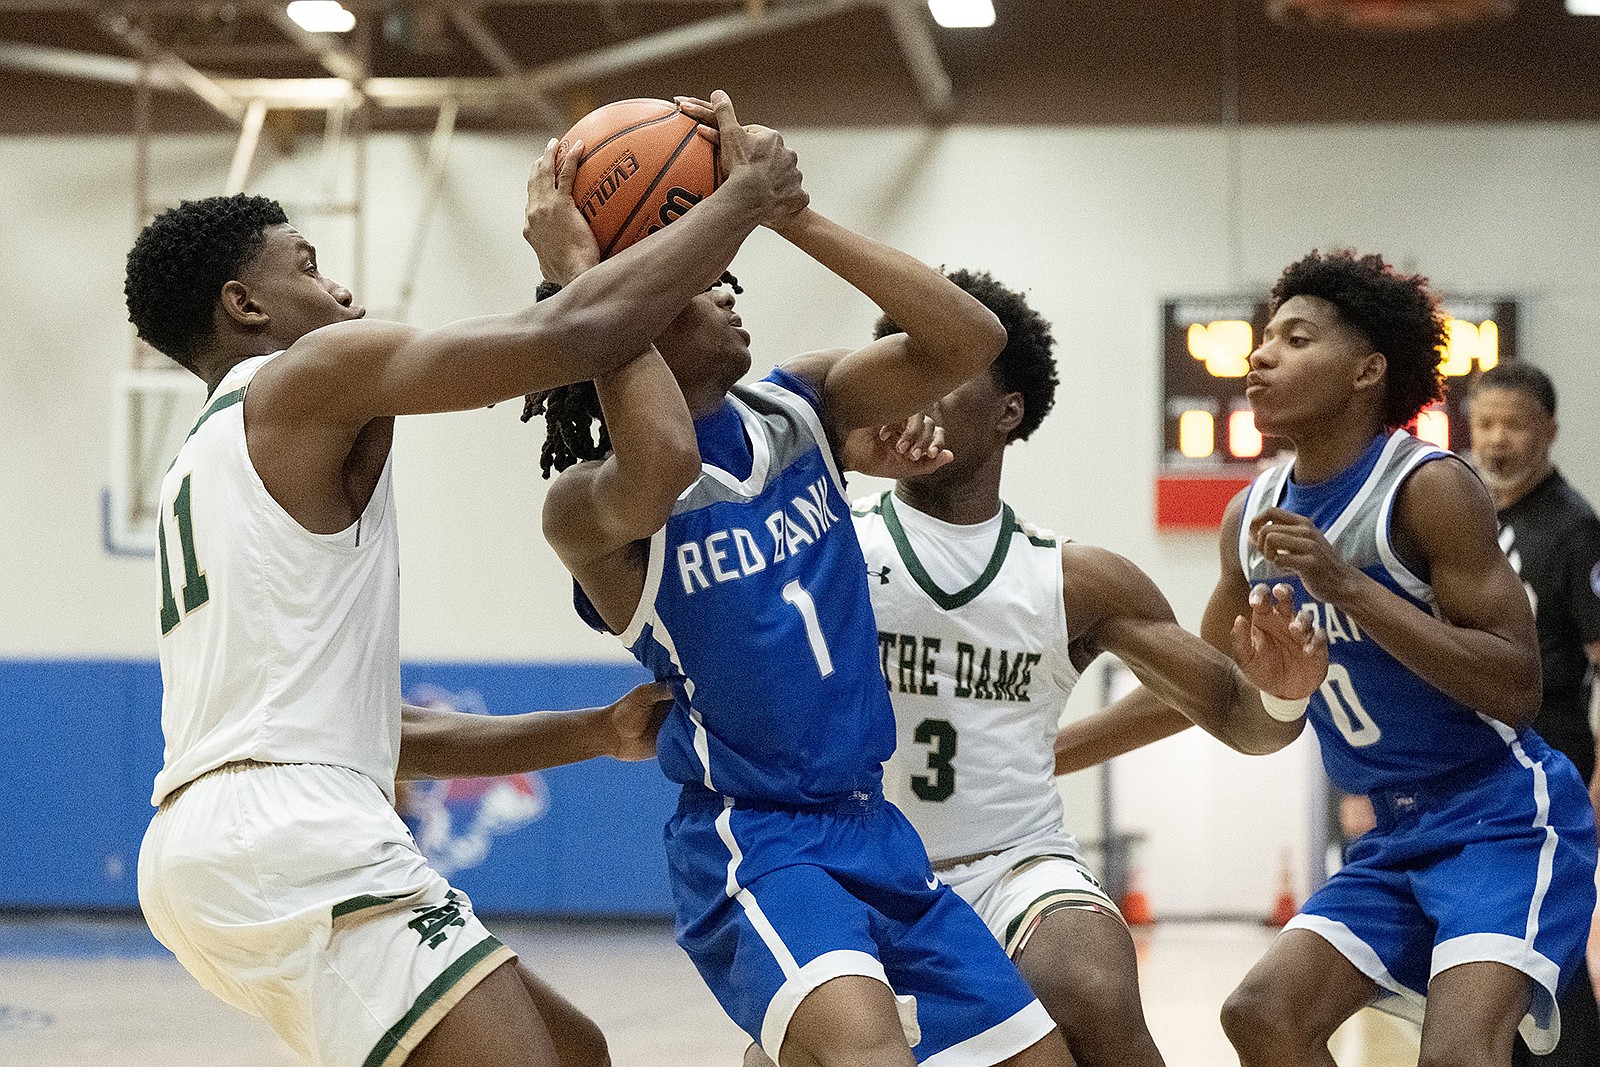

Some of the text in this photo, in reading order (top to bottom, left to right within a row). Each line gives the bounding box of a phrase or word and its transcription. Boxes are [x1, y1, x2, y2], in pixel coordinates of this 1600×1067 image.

[158, 469, 211, 639] 11
[677, 475, 839, 594] RED BANK
[782, 578, 835, 680] 1
[954, 641, 1042, 702] DAME
[1319, 663, 1382, 747] 0
[911, 717, 957, 802] 3
